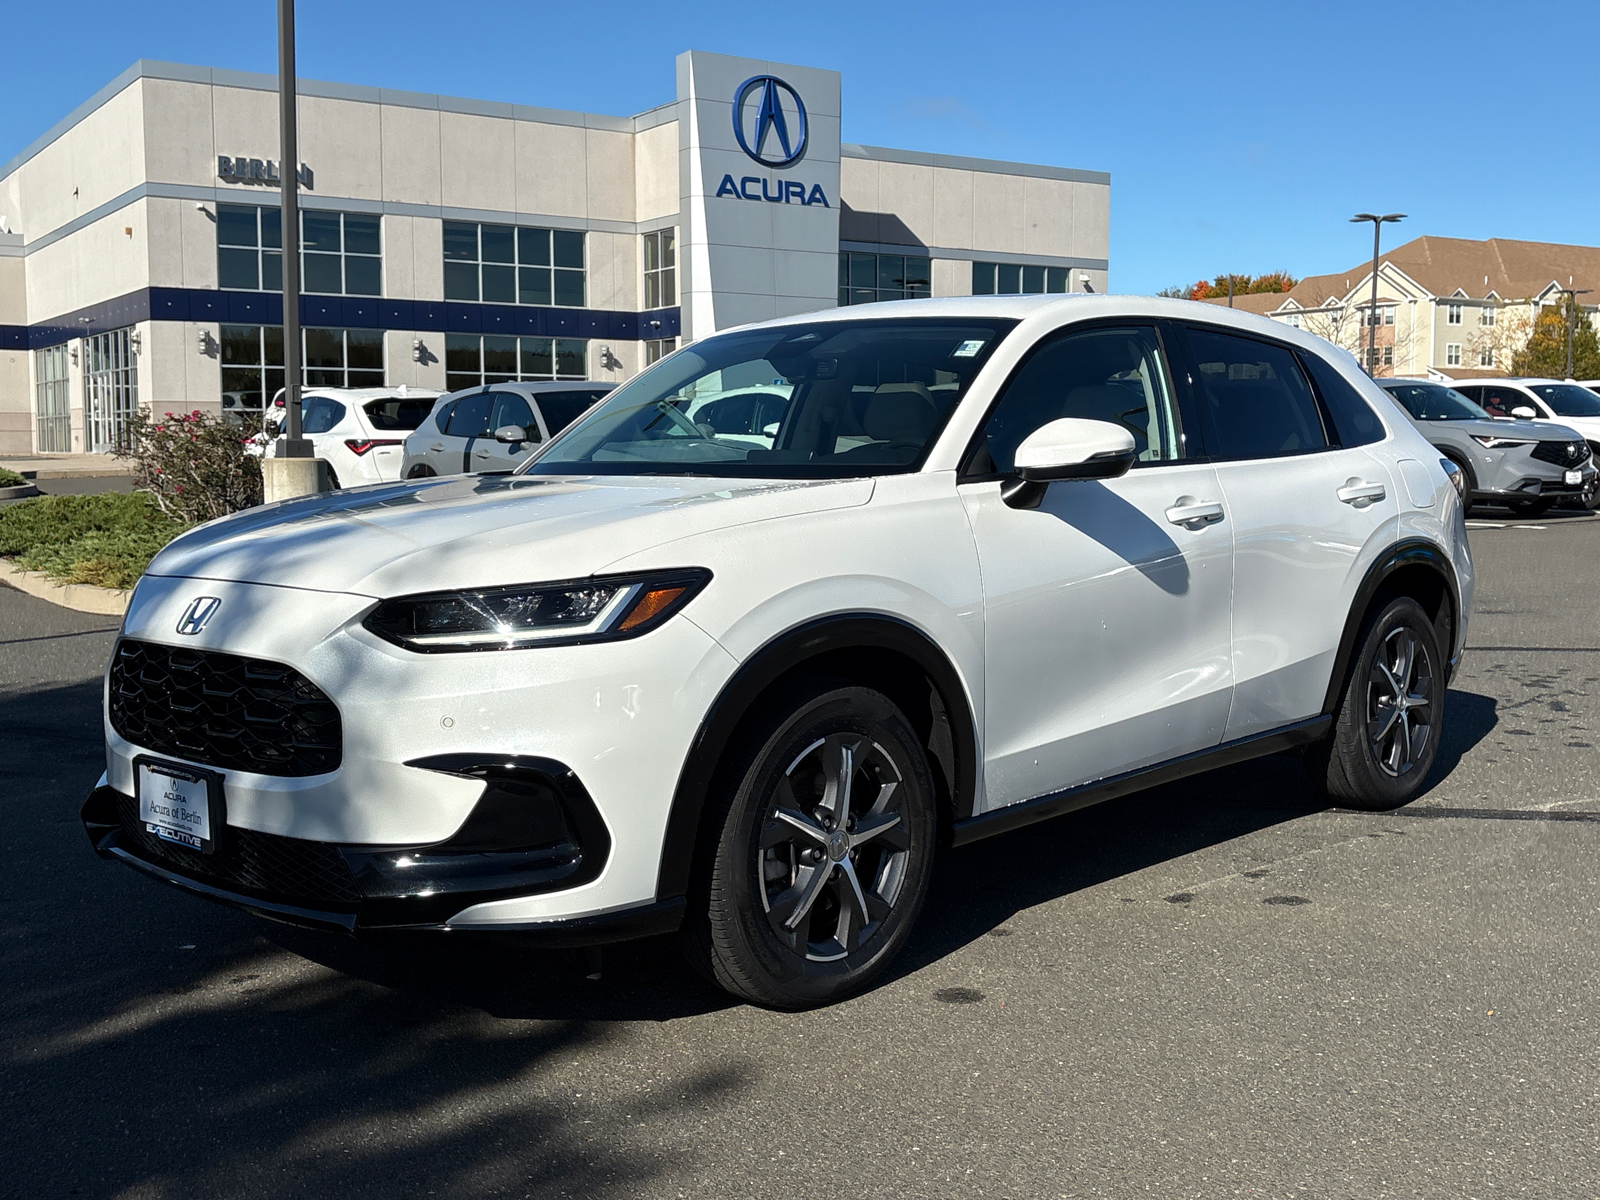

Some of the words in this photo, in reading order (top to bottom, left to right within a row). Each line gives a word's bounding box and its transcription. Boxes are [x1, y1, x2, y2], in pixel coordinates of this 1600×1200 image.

[218, 155, 307, 183] BERLN
[716, 173, 831, 208] ACURA
[163, 791, 187, 804] ACURA
[149, 800, 170, 817] Acura
[171, 807, 179, 819] of
[181, 807, 202, 825] Berlin
[146, 823, 201, 848] EXECUTIVE
